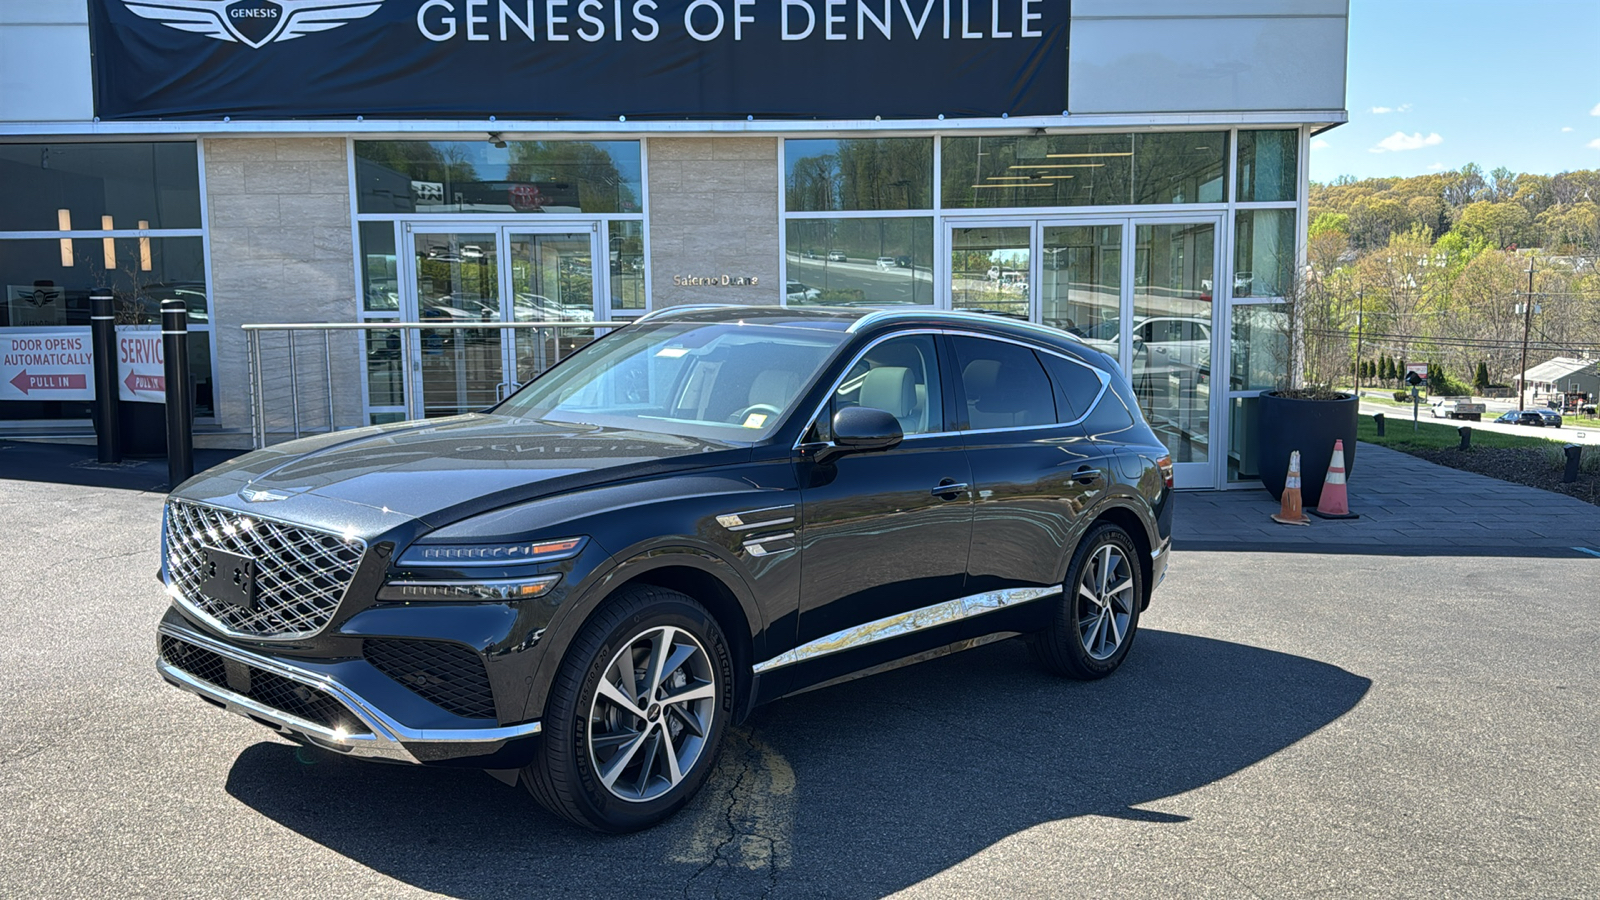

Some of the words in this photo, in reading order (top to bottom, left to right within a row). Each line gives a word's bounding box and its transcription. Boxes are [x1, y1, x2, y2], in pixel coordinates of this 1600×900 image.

[230, 8, 278, 18] GENESIS
[416, 0, 660, 42] GENESIS
[684, 0, 756, 42] OF
[781, 0, 1043, 41] DENVILLE
[673, 274, 719, 286] Salerno
[721, 274, 759, 286] Duane
[12, 339, 42, 351] DOOR
[45, 338, 82, 350] OPENS
[120, 338, 164, 364] SERVIC
[4, 353, 92, 366] AUTOMATICALLY
[30, 377, 55, 387] PULL
[58, 376, 69, 387] IN
[135, 376, 151, 388] PULL
[152, 378, 159, 389] IN
[580, 671, 596, 707] 265/50
[594, 662, 600, 671] R
[599, 649, 608, 663] 20
[716, 643, 732, 710] MICHELIN
[576, 719, 595, 792] MICHELIN
